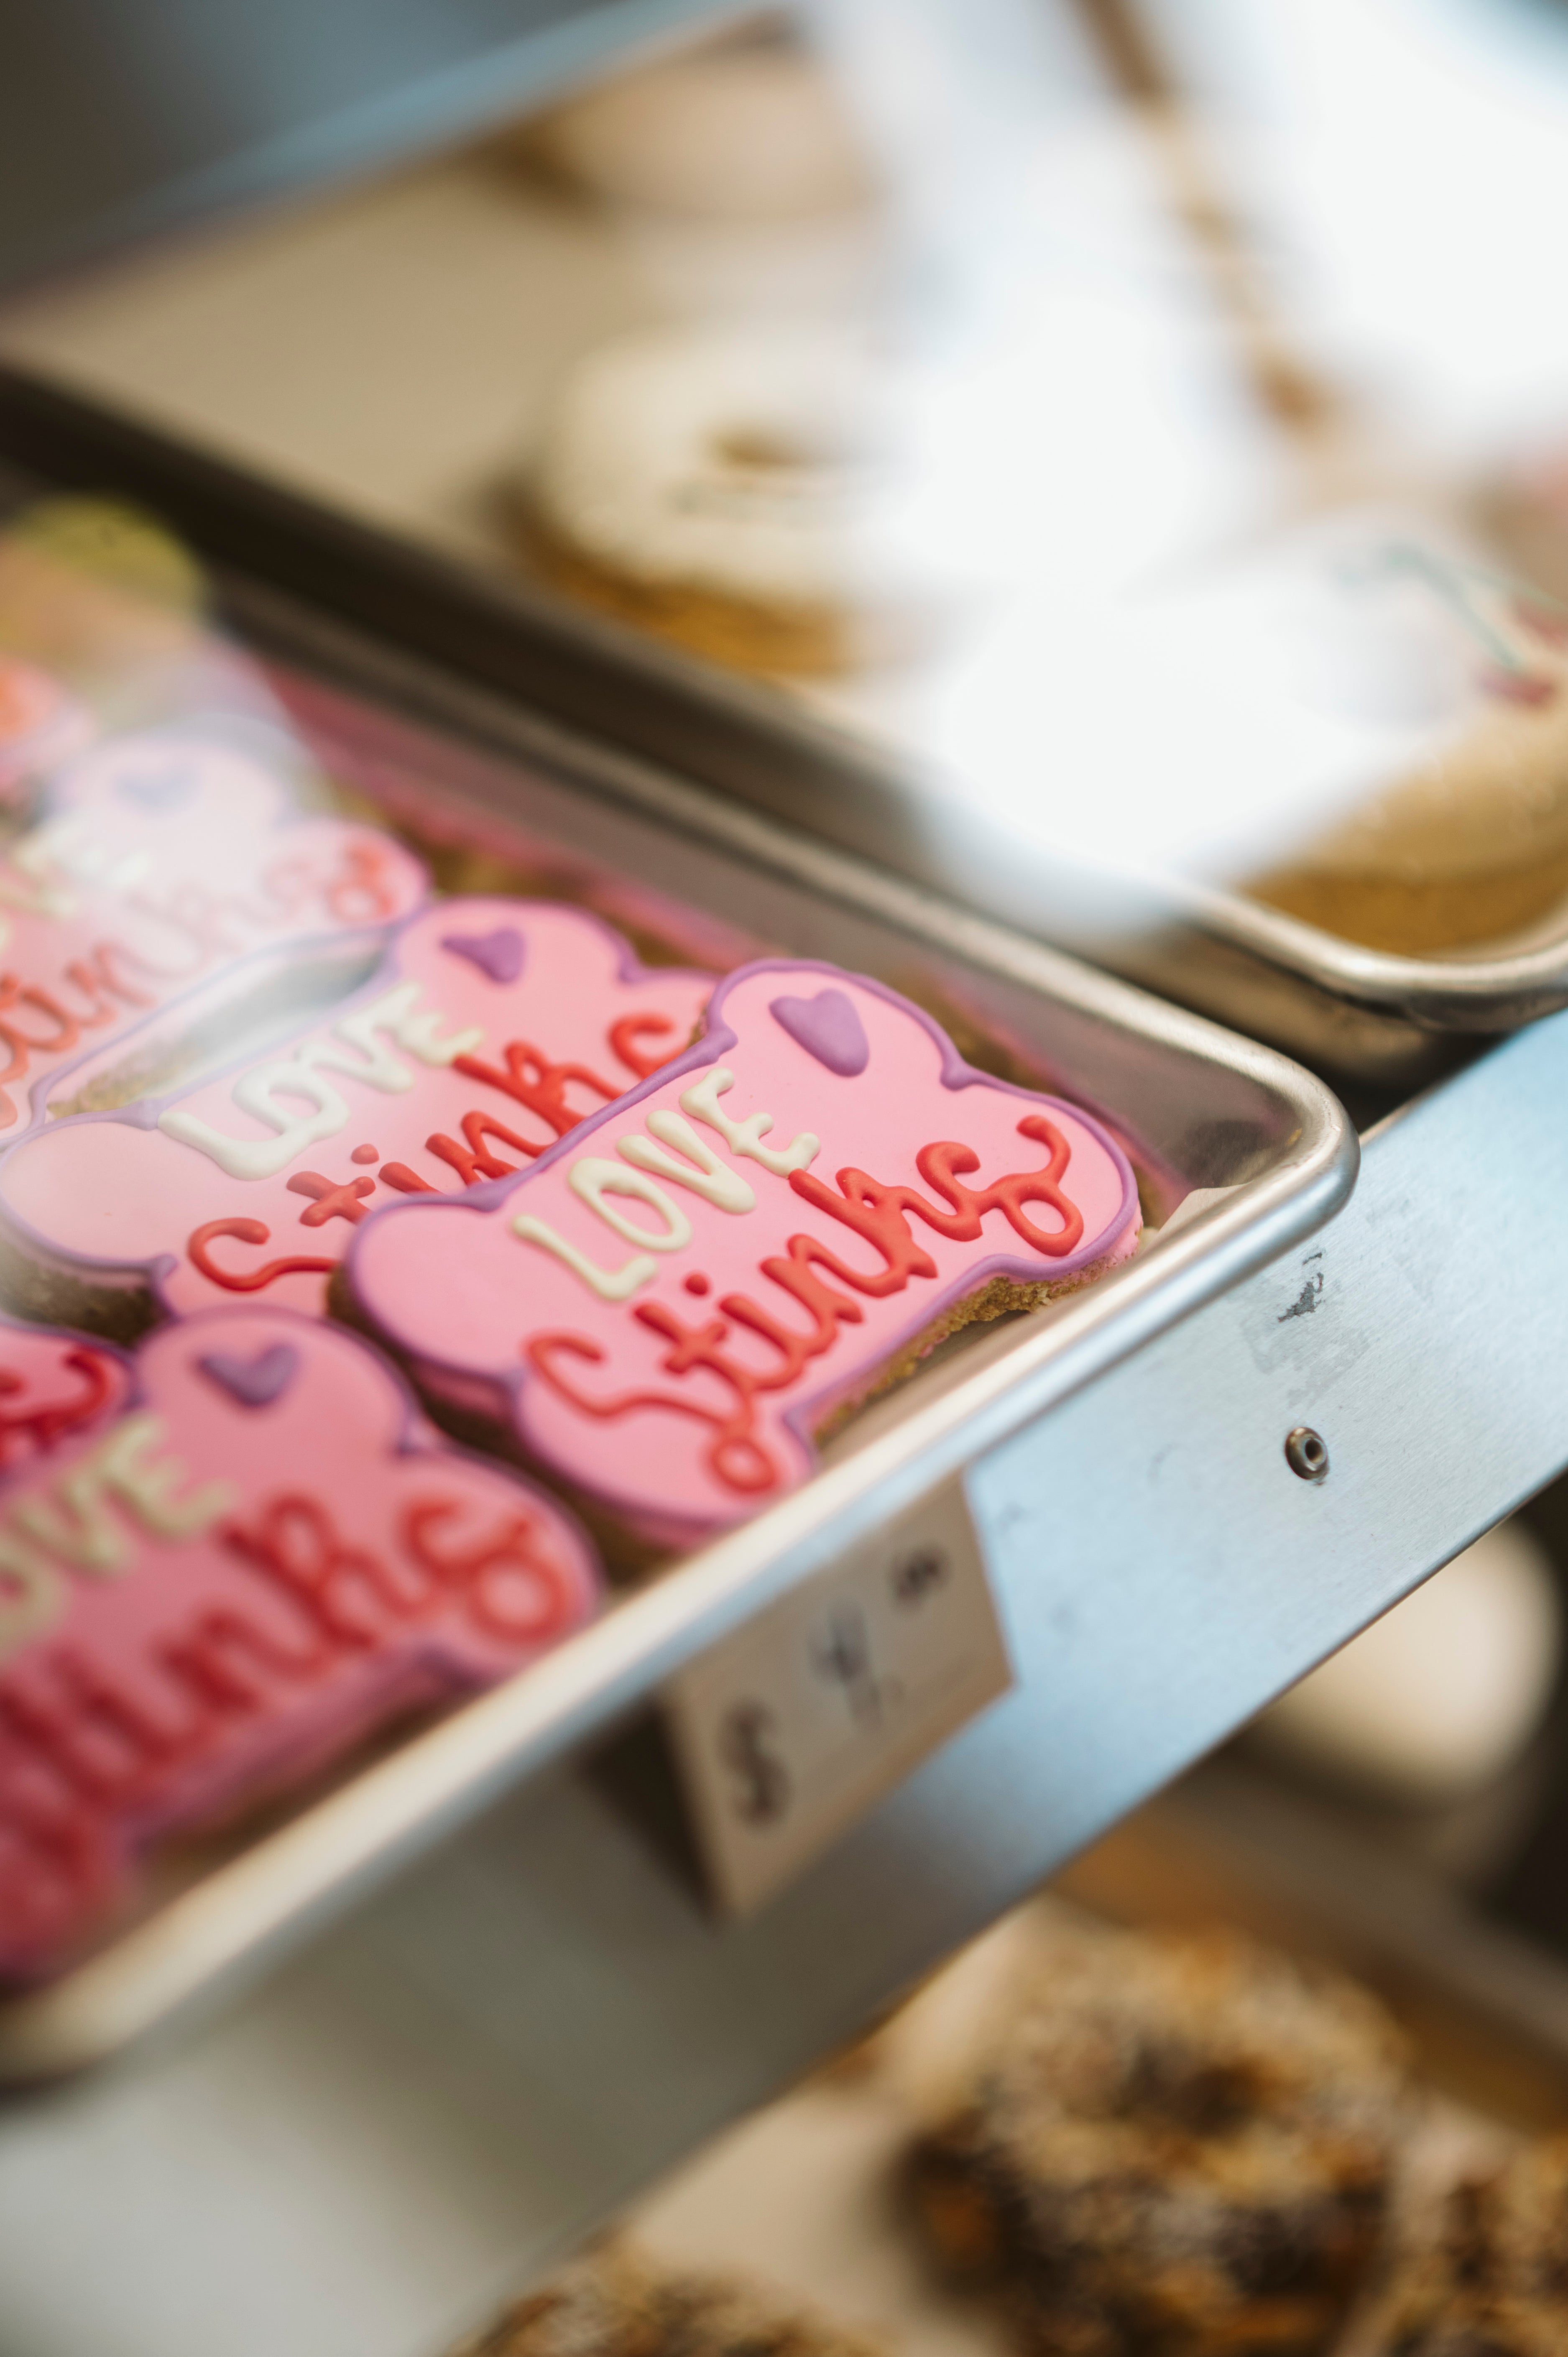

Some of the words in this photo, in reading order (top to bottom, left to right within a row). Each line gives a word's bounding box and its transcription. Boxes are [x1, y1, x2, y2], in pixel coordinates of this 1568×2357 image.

[158, 983, 487, 1181] LOVE
[509, 1066, 822, 1301] LOVE
[522, 1113, 1085, 1498] Stinks
